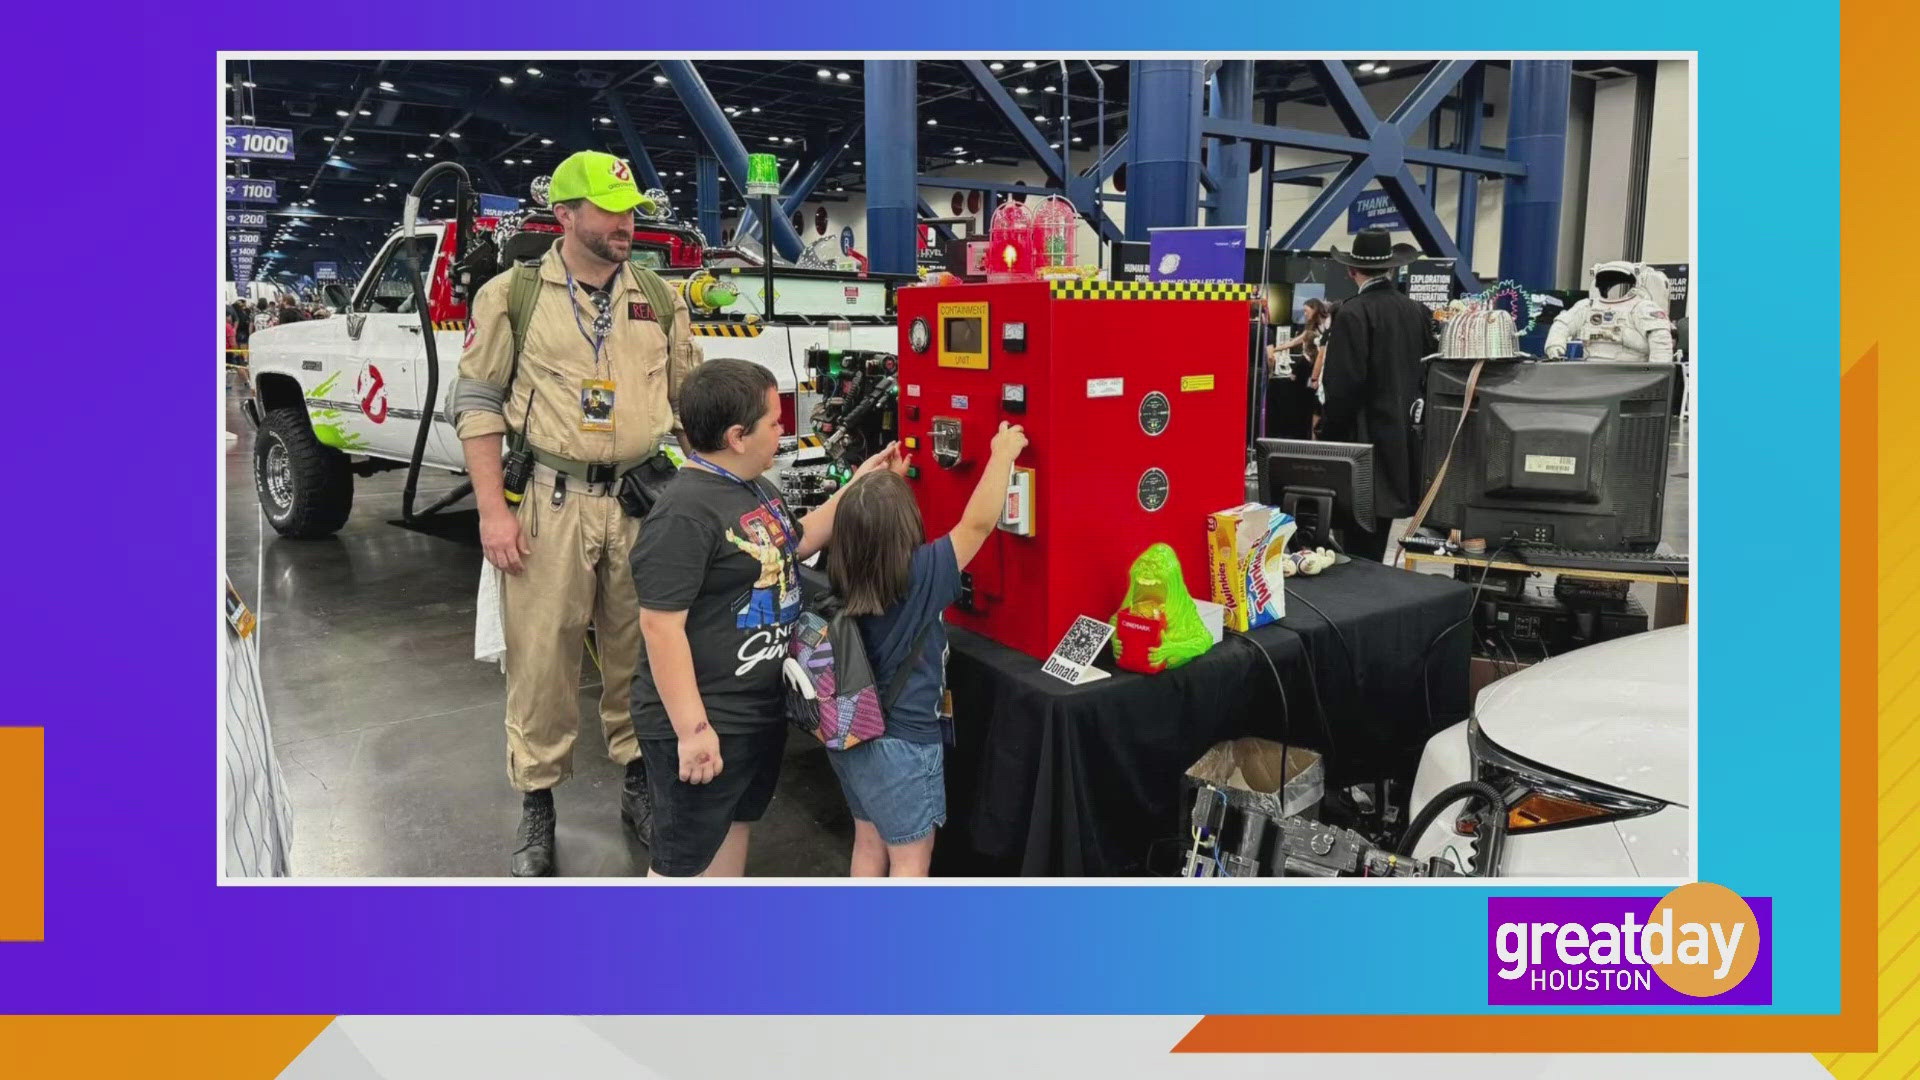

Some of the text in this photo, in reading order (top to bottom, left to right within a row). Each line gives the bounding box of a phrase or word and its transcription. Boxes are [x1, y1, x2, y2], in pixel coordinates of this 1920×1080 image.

[241, 134, 289, 154] 1000
[242, 185, 273, 198] 1100
[1357, 195, 1389, 212] THANK
[239, 214, 264, 225] 1200
[239, 234, 259, 243] 1300
[920, 248, 943, 258] LEVEL
[1410, 274, 1451, 284] EXPLORATION
[1669, 278, 1687, 286] ULAR
[940, 304, 987, 316] CONTAINMENT
[955, 355, 971, 365] UNIT
[1250, 545, 1272, 613] Twinkies
[1218, 562, 1238, 610] Twinkies
[1238, 573, 1246, 603] FAMILY
[1121, 620, 1151, 632] CINEMARK
[1044, 656, 1080, 683] Donate
